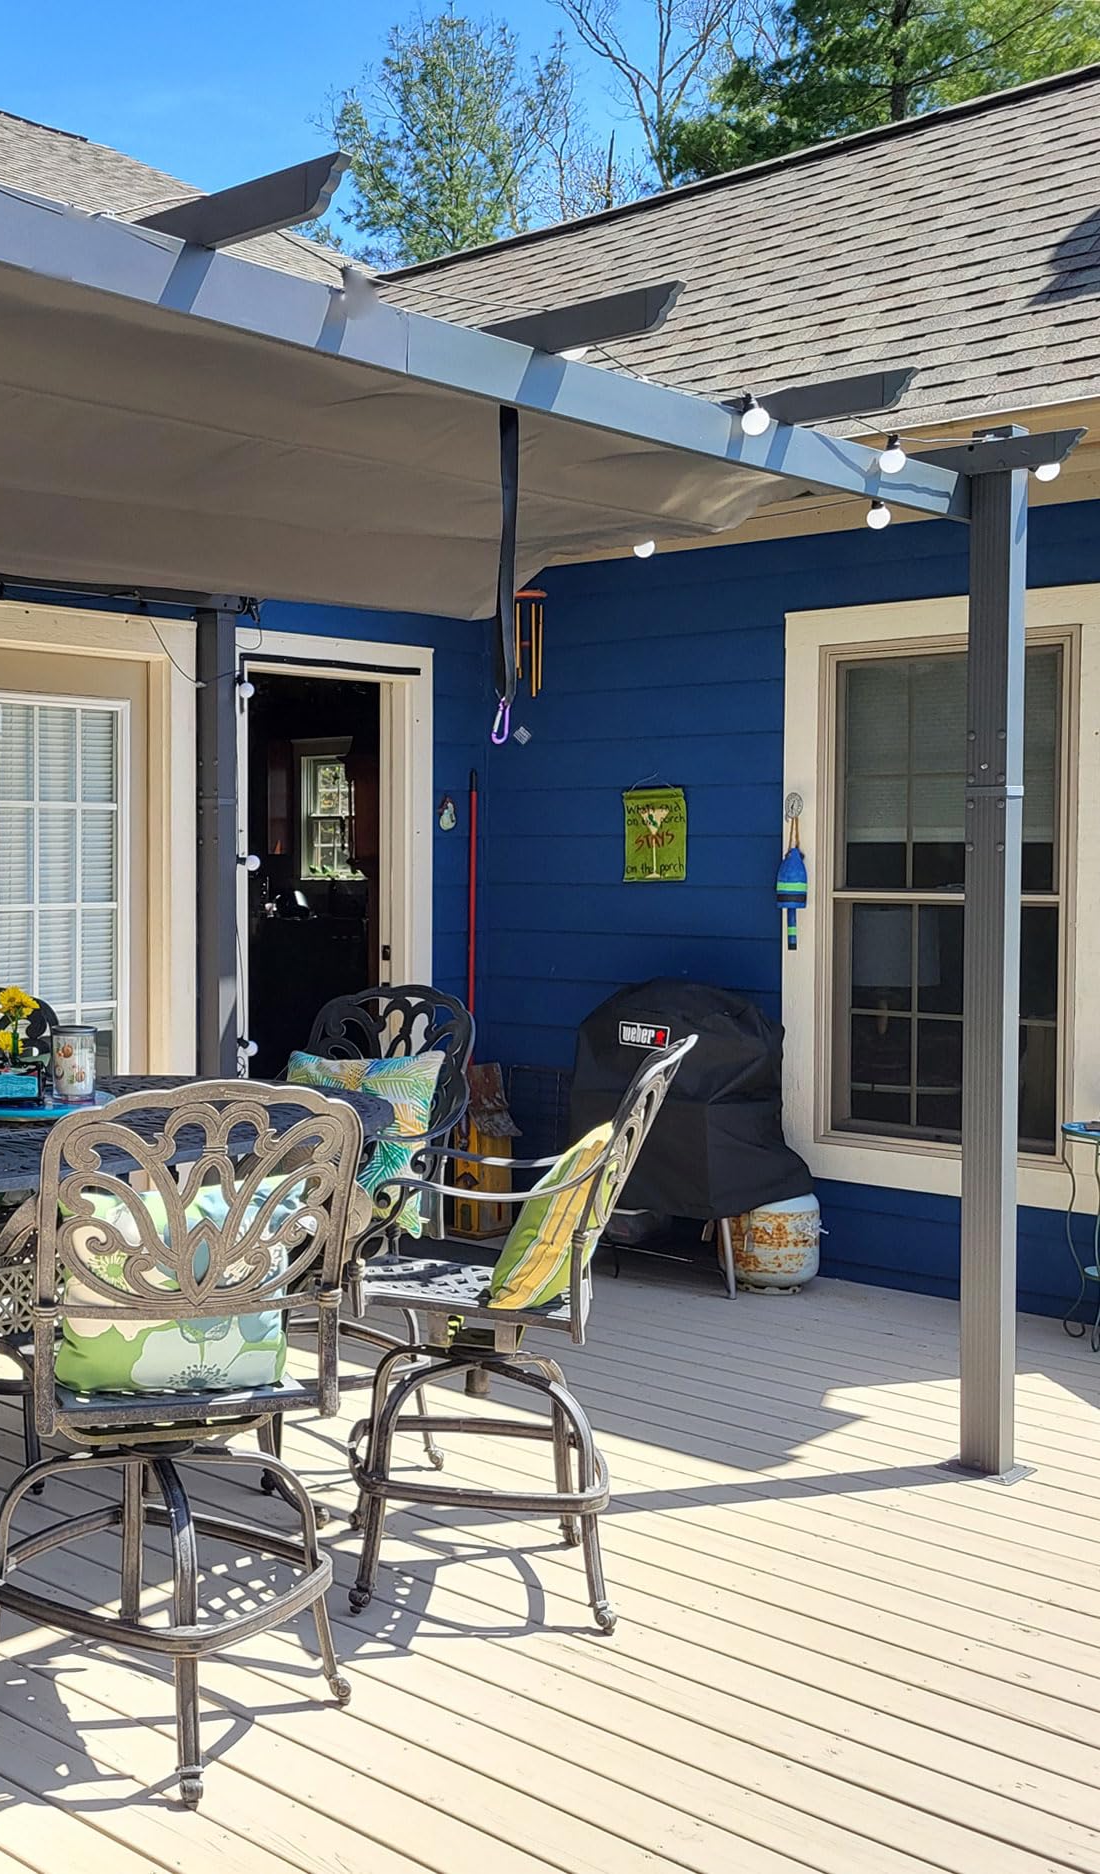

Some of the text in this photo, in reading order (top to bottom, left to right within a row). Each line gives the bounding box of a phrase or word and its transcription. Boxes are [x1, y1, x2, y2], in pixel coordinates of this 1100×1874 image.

[627, 818, 638, 826] on
[635, 830, 674, 853] STAYS
[626, 864, 637, 874] on
[659, 857, 684, 875] porch
[622, 1024, 655, 1045] weber
